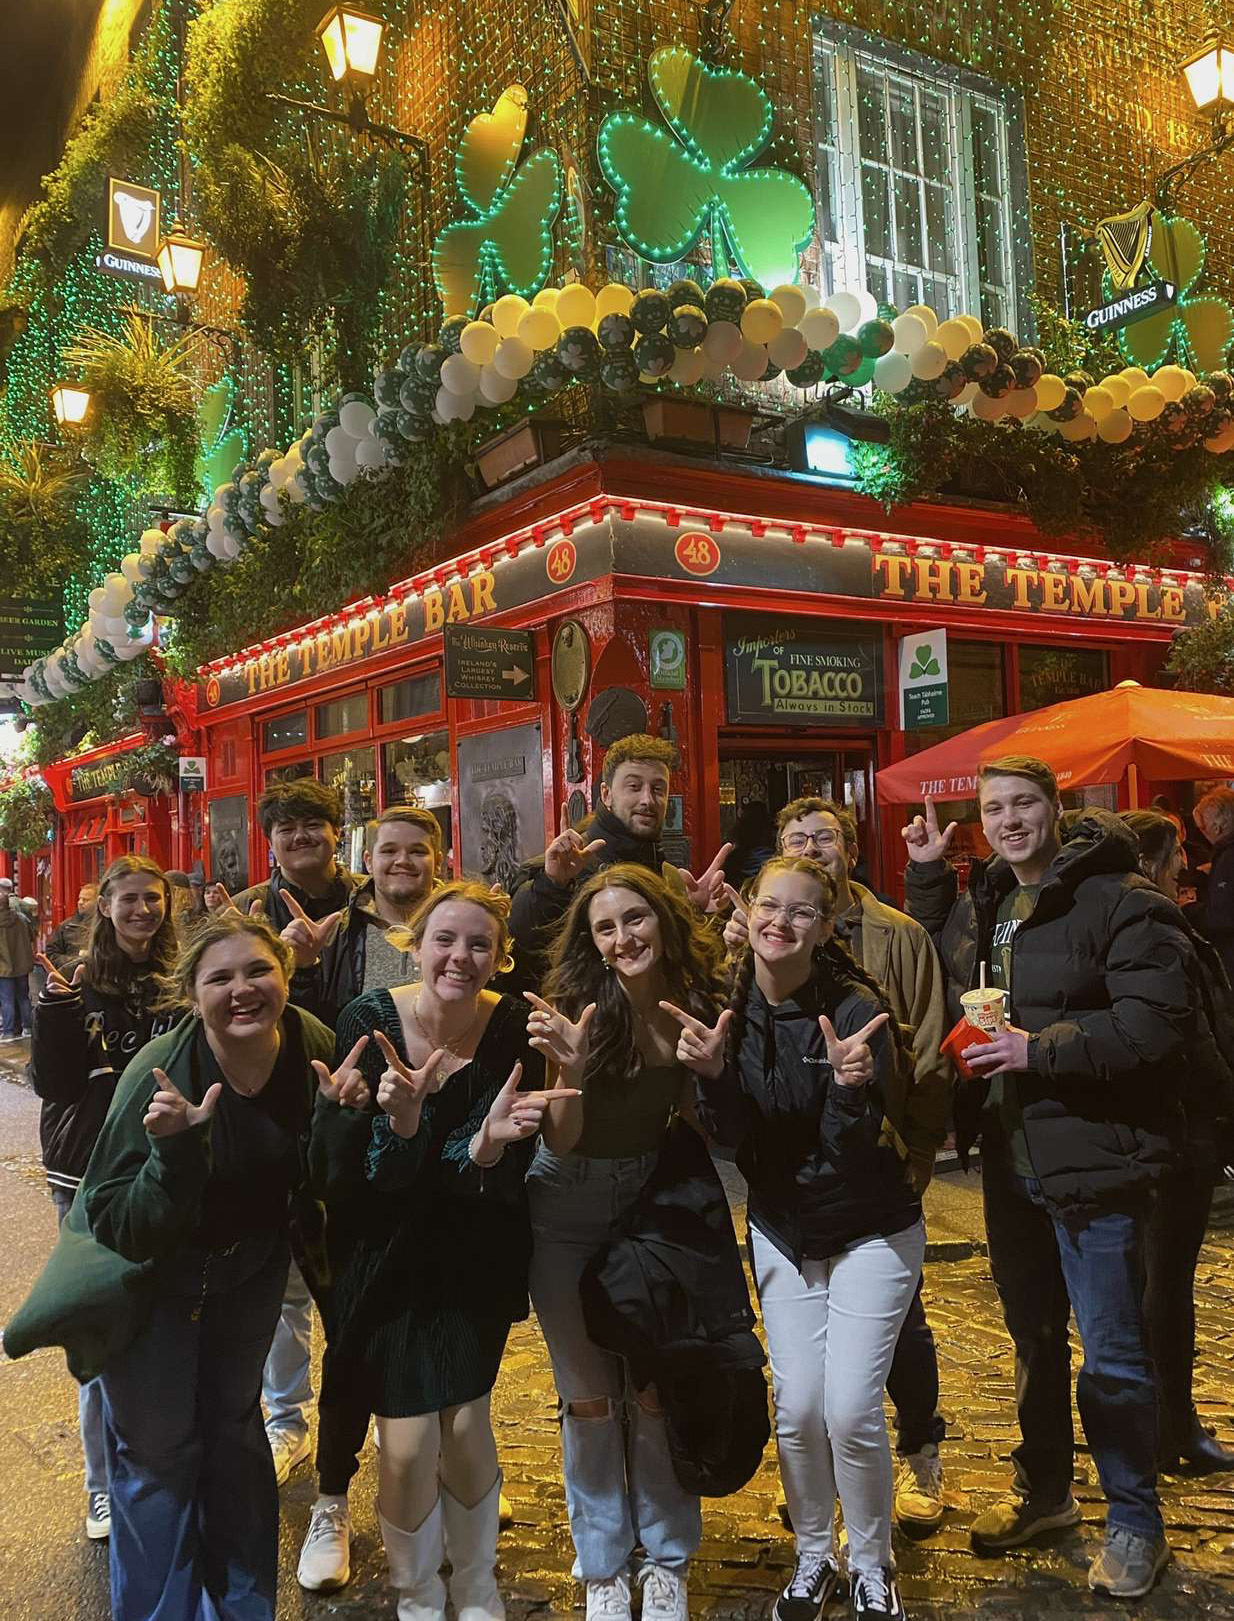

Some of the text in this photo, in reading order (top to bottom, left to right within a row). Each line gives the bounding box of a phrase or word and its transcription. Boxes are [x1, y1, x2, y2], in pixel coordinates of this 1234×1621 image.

[1086, 286, 1158, 329] GUINNESS
[682, 537, 711, 565] 48
[551, 548, 571, 577] 48
[872, 553, 988, 604] THE
[1006, 568, 1187, 622] TEMPLE
[22, 618, 59, 627] GARDEN
[243, 571, 497, 694] THE TEMPLE BAR
[1, 648, 24, 656] LIVE
[773, 646, 785, 656] OF
[790, 653, 861, 669] FINE SMOKING
[454, 681, 502, 691] COLLECTION
[460, 673, 496, 683] WHISKEY
[751, 657, 864, 708] TOBACCO
[775, 699, 873, 714] Always in Stock
[919, 779, 946, 795] THE
